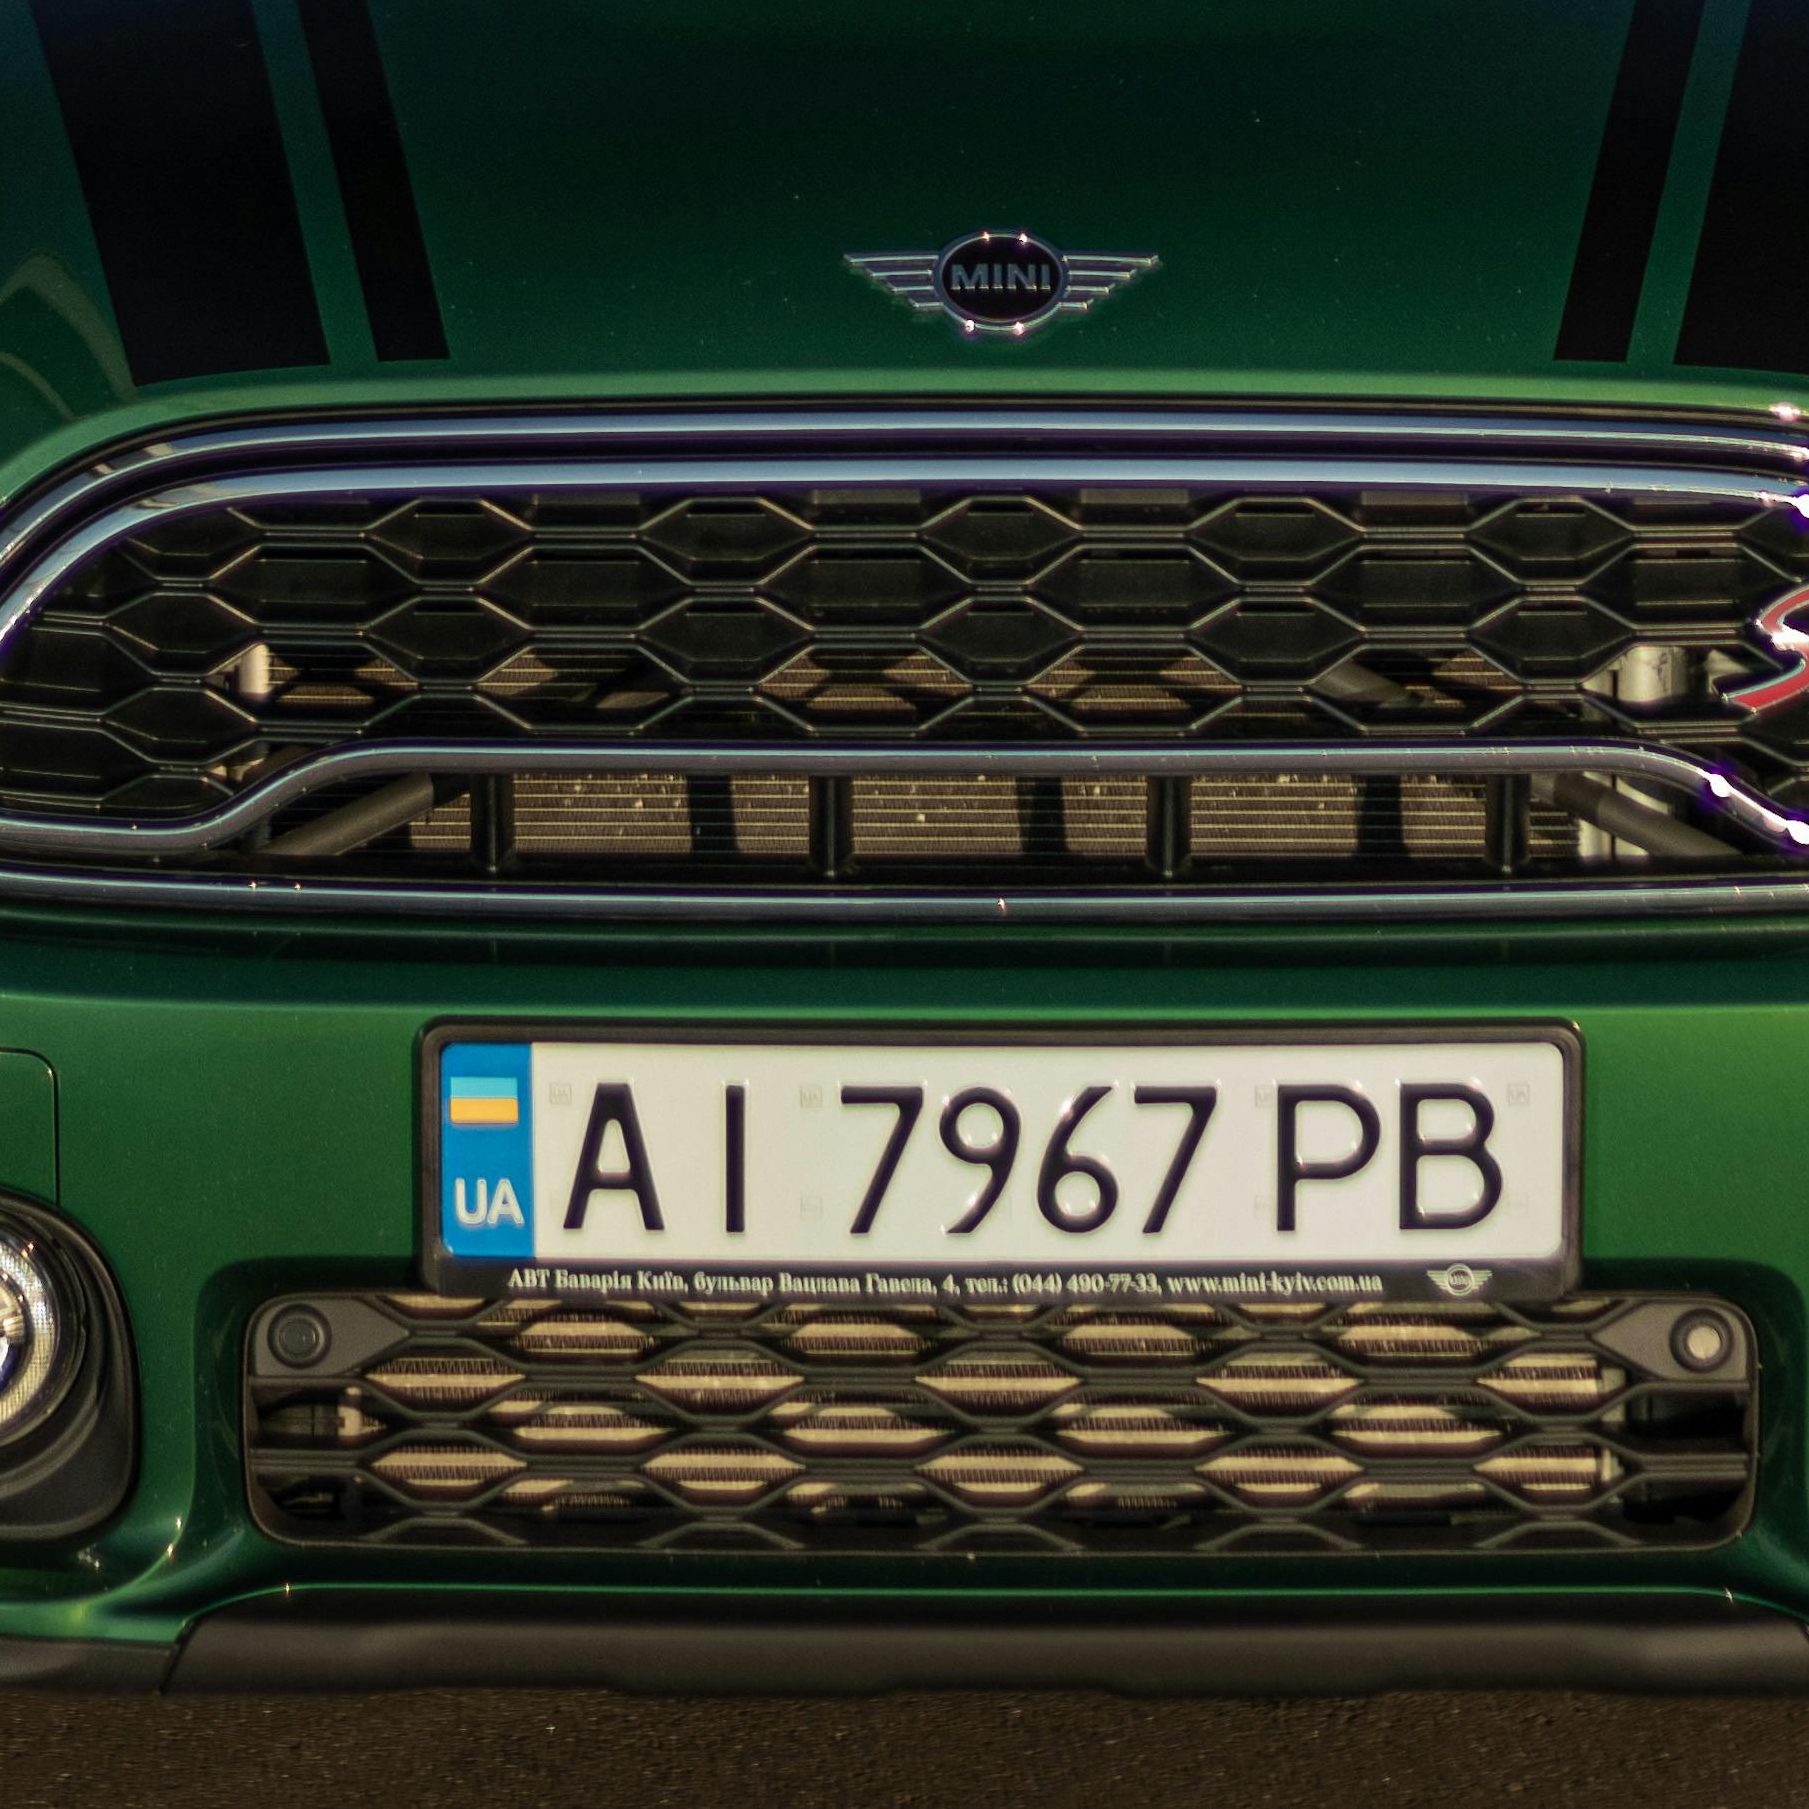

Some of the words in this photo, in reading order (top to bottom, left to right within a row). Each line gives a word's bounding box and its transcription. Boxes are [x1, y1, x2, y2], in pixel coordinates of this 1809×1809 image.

[950, 262, 1052, 291] MINI
[840, 1085, 1218, 1234] 7967
[1276, 1082, 1503, 1232] PB
[454, 1177, 525, 1226] UA
[942, 1273, 960, 1296] 4,
[1012, 1272, 1062, 1295] (044)
[1066, 1272, 1162, 1297] 490-77-33,
[1166, 1271, 1383, 1296] www.mini-kyiv.com.ua
